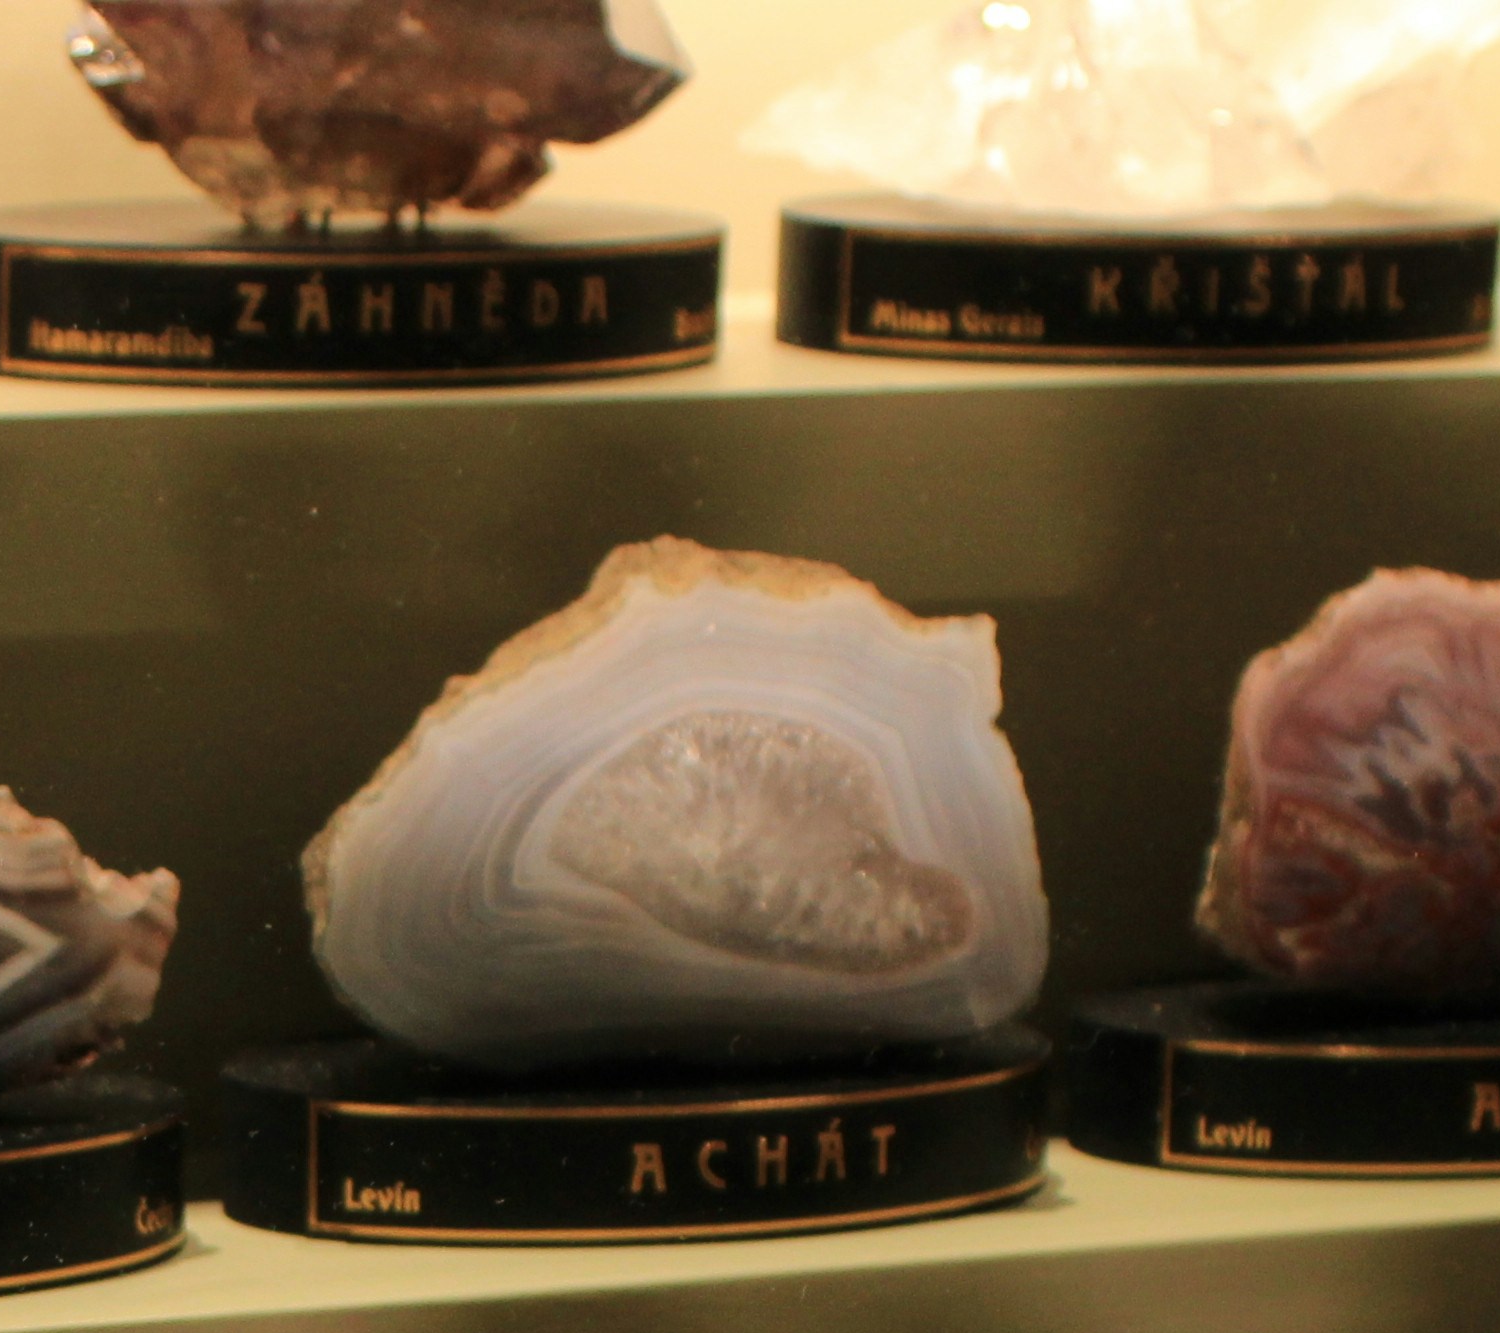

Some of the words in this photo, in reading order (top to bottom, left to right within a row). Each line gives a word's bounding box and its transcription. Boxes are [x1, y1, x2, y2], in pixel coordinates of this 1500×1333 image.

[237, 272, 608, 333] ZÁHNĚDA
[630, 1118, 895, 1192] ACHÁT
[1196, 1116, 1272, 1148] Levín
[344, 1178, 421, 1213] Levín
